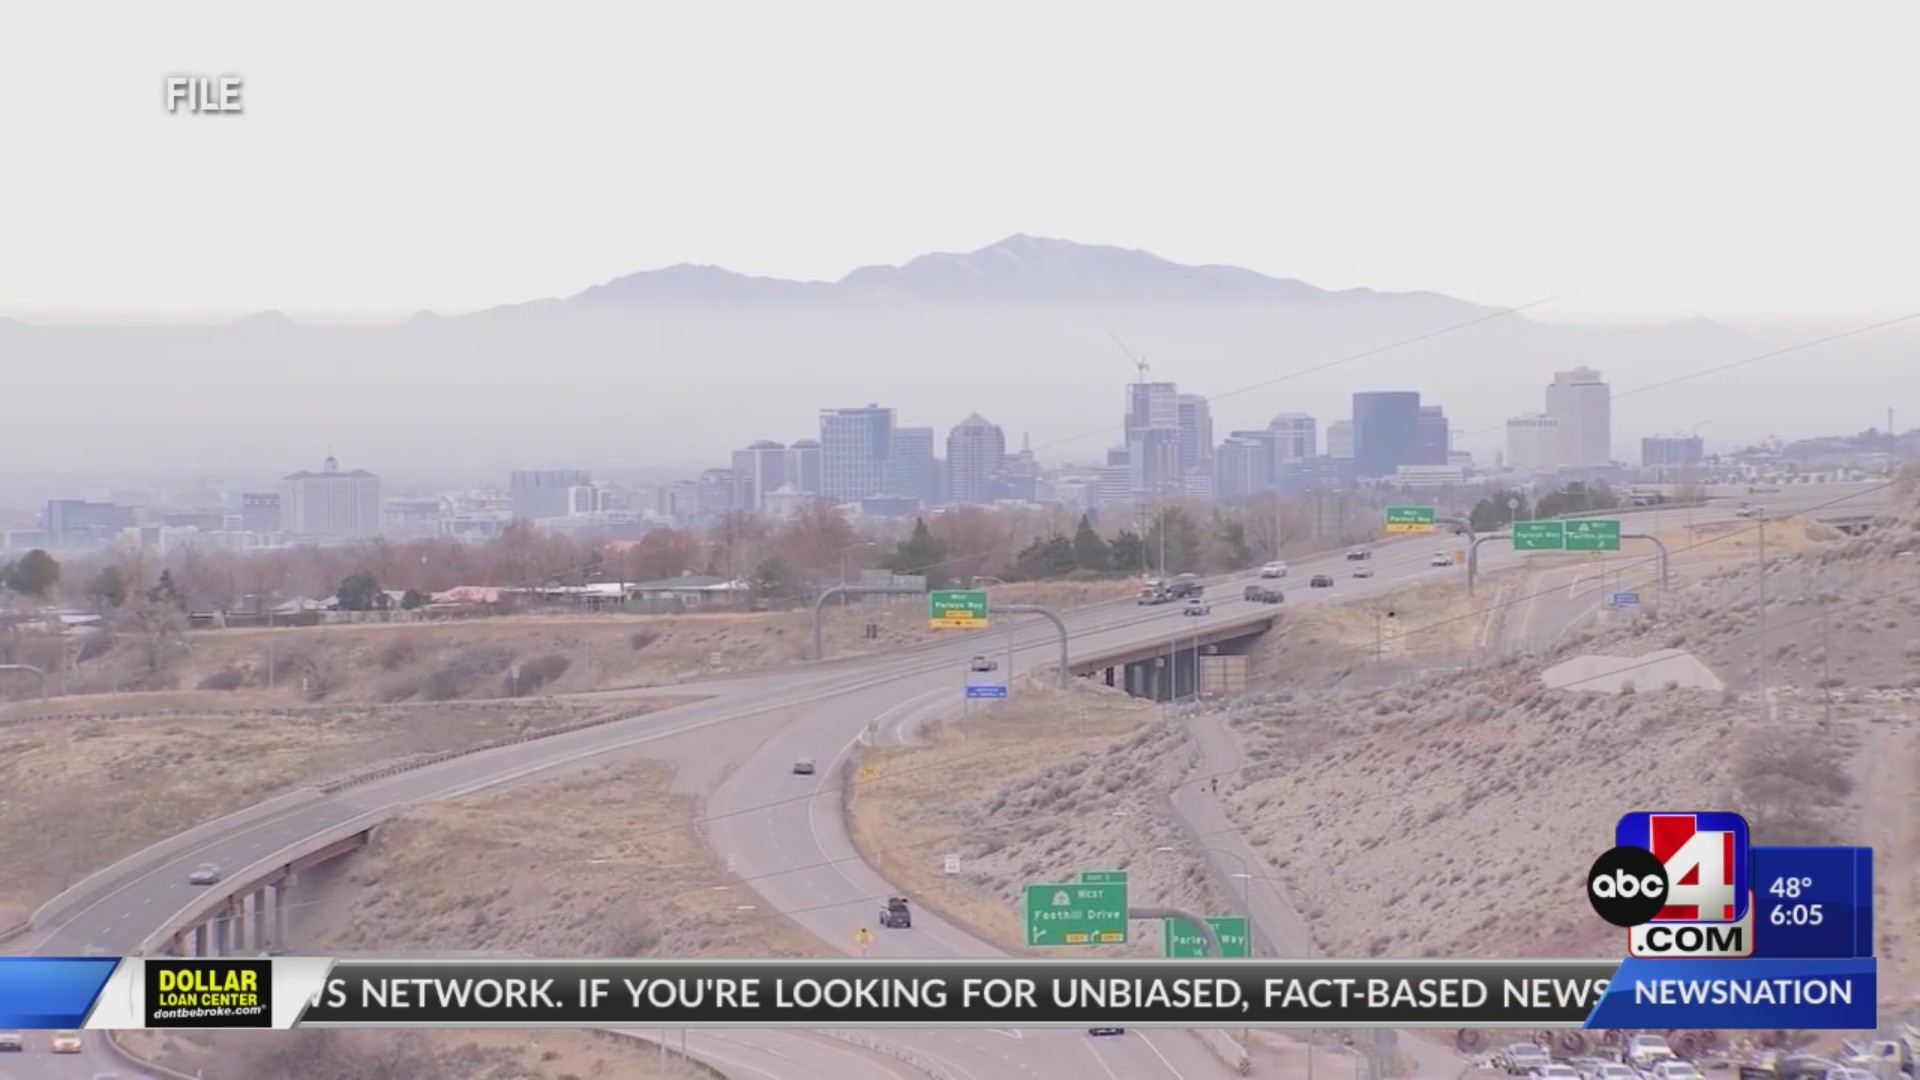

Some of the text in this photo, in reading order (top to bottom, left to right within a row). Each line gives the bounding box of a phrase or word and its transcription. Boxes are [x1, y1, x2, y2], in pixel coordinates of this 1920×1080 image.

[1077, 889, 1104, 899] WEST
[1034, 909, 1121, 920] Foothill Drive
[1221, 934, 1245, 946] Way
